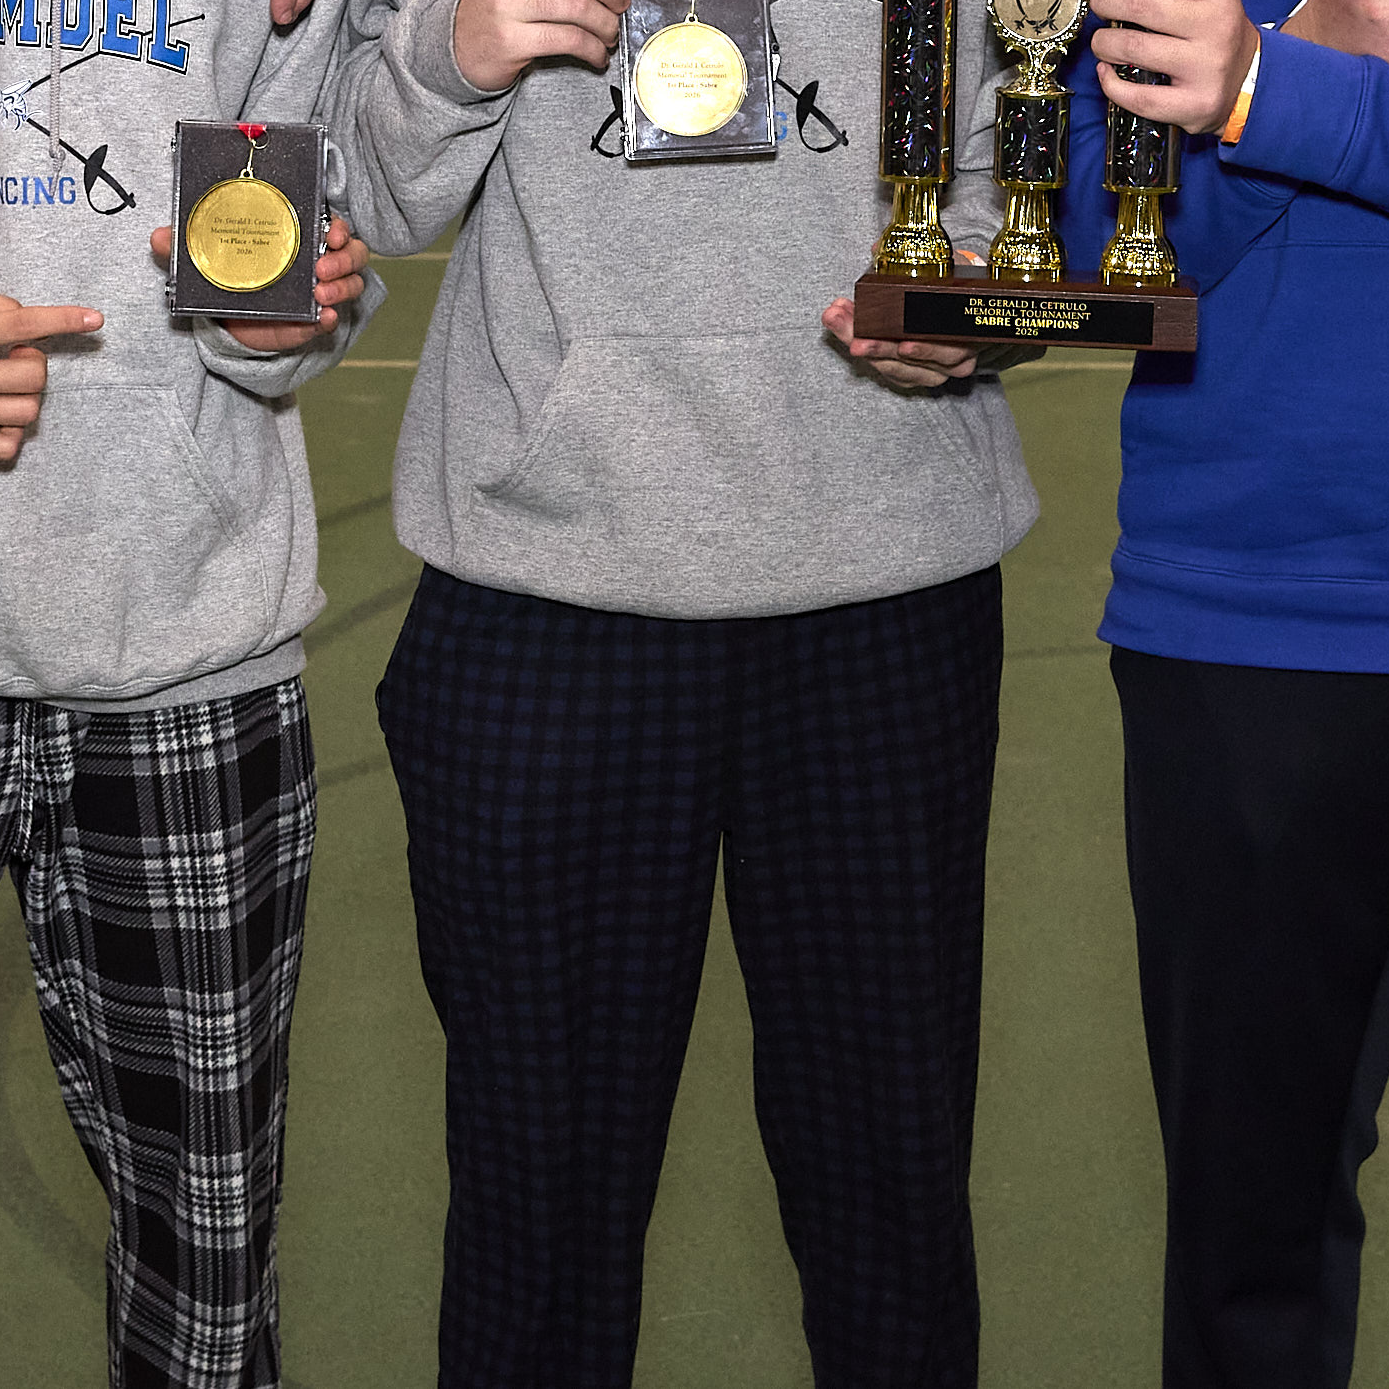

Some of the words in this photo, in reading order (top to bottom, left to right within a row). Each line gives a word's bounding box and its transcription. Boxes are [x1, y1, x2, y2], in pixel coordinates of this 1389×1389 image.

[211, 227, 240, 235] Memorial
[242, 228, 280, 236] Tournament
[230, 237, 247, 245] Place
[969, 298, 986, 307] DR.
[988, 299, 1029, 308] GERALD
[1040, 301, 1087, 311] CETRULO
[964, 307, 1018, 317] MEMORIAL
[1020, 309, 1091, 321] TOURNAMENT
[975, 316, 1011, 327] SABRE
[1014, 318, 1080, 330] CHAMPIONS
[1015, 327, 1039, 336] 2026
